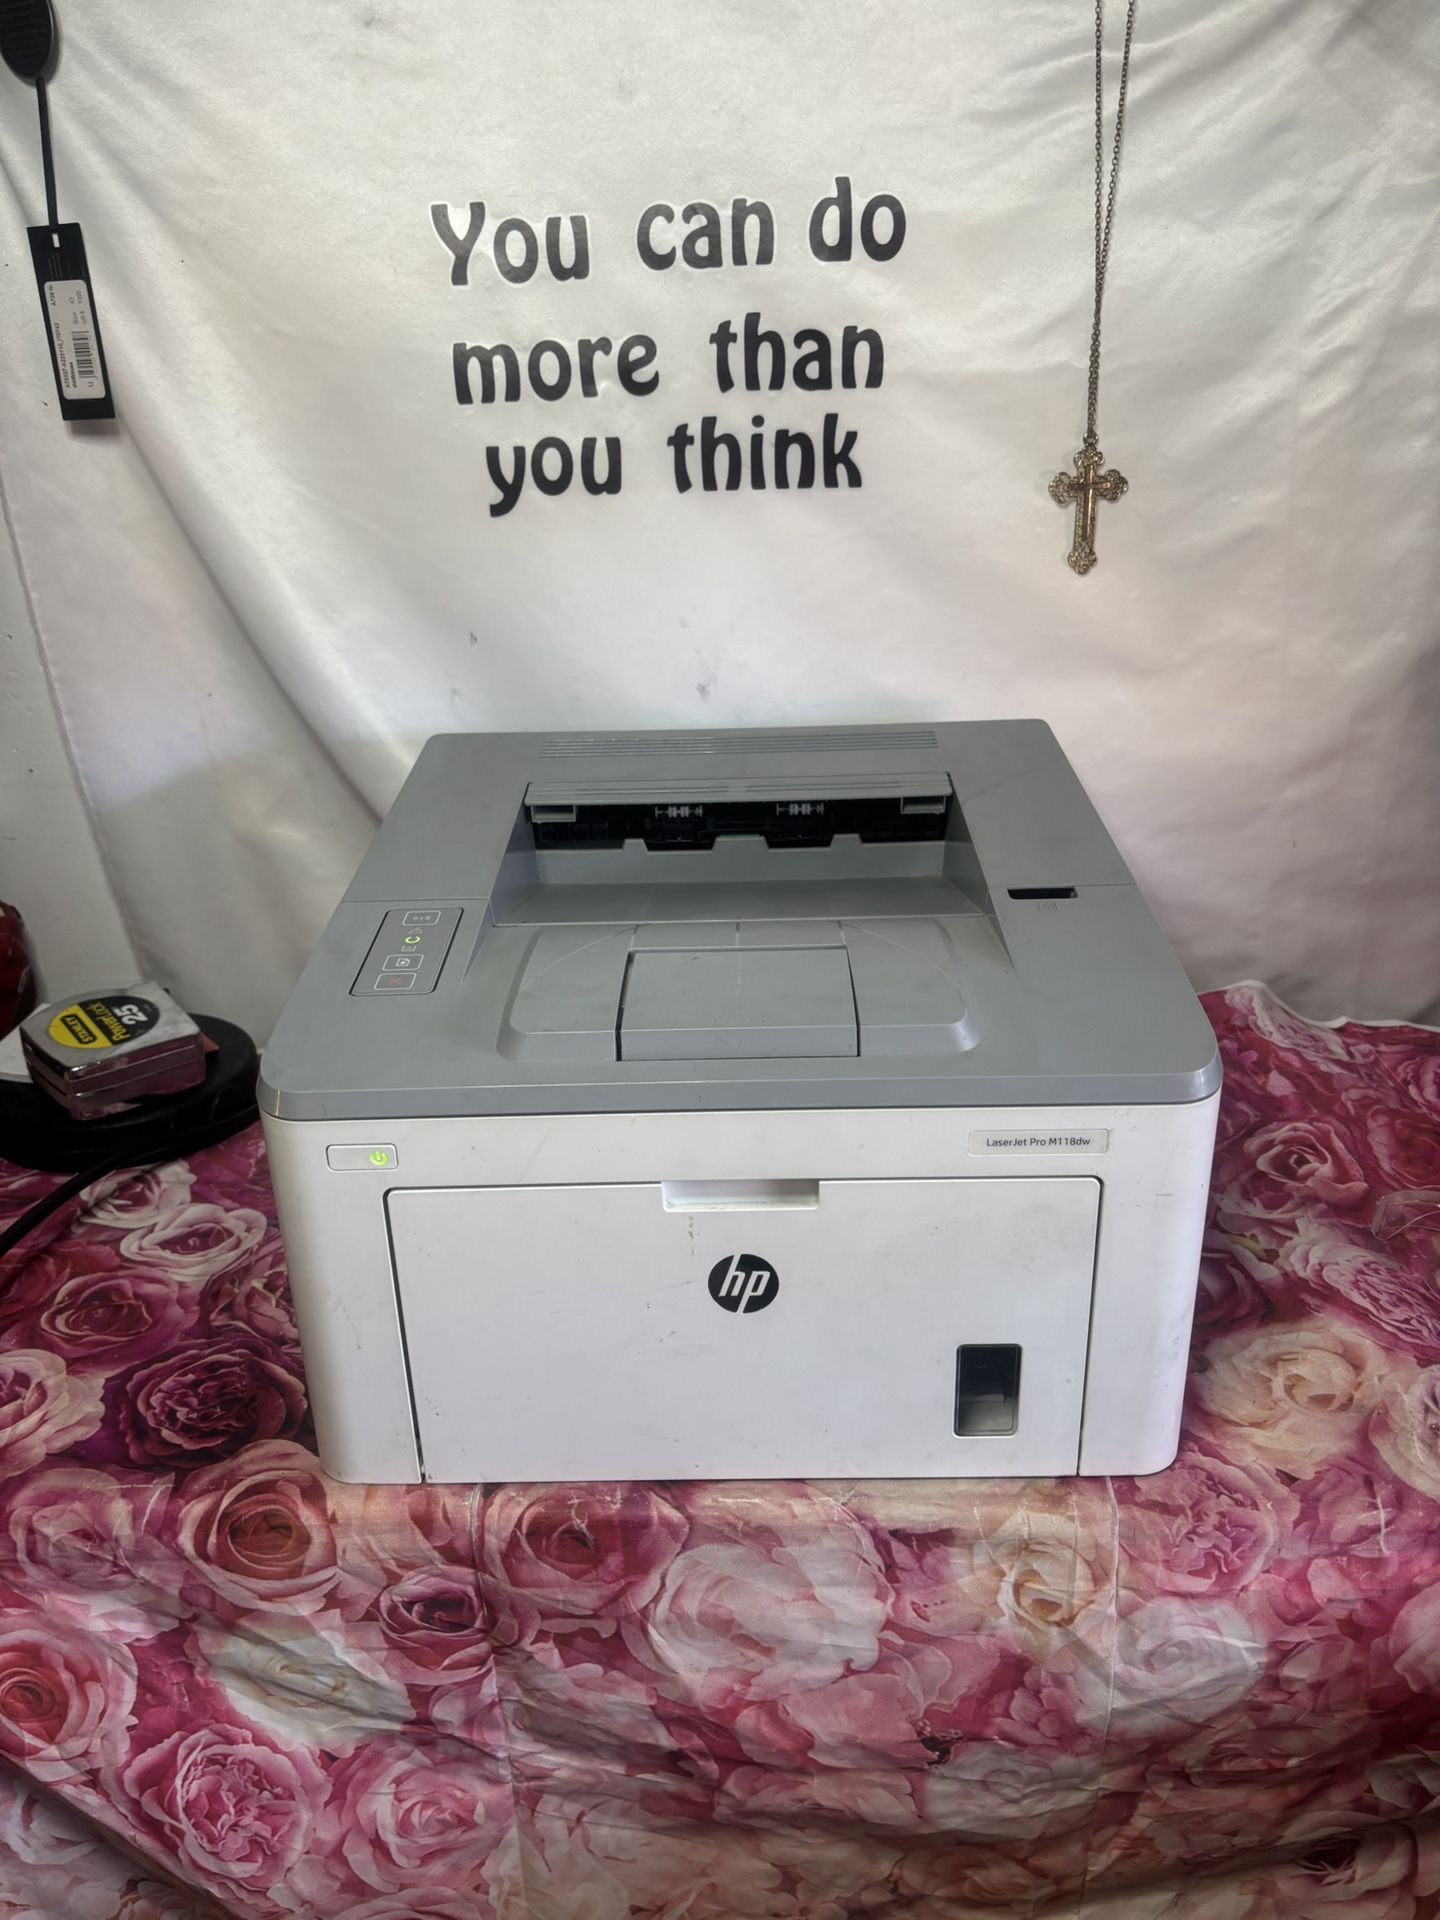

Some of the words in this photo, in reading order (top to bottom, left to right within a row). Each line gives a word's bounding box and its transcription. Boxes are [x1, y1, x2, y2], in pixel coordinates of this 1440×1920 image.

[430, 201, 591, 286] You
[636, 197, 775, 271] can
[808, 176, 907, 262] do
[452, 334, 660, 405] more
[709, 312, 884, 393] than
[485, 436, 622, 518] you
[667, 413, 862, 494] think
[63, 1015, 94, 1043] STANLEY
[111, 1004, 149, 1026] 25
[986, 1137, 1027, 1147] LaserJet
[1029, 1137, 1047, 1146] Pro
[1048, 1136, 1091, 1146] M118dw
[717, 1253, 771, 1314] hp
